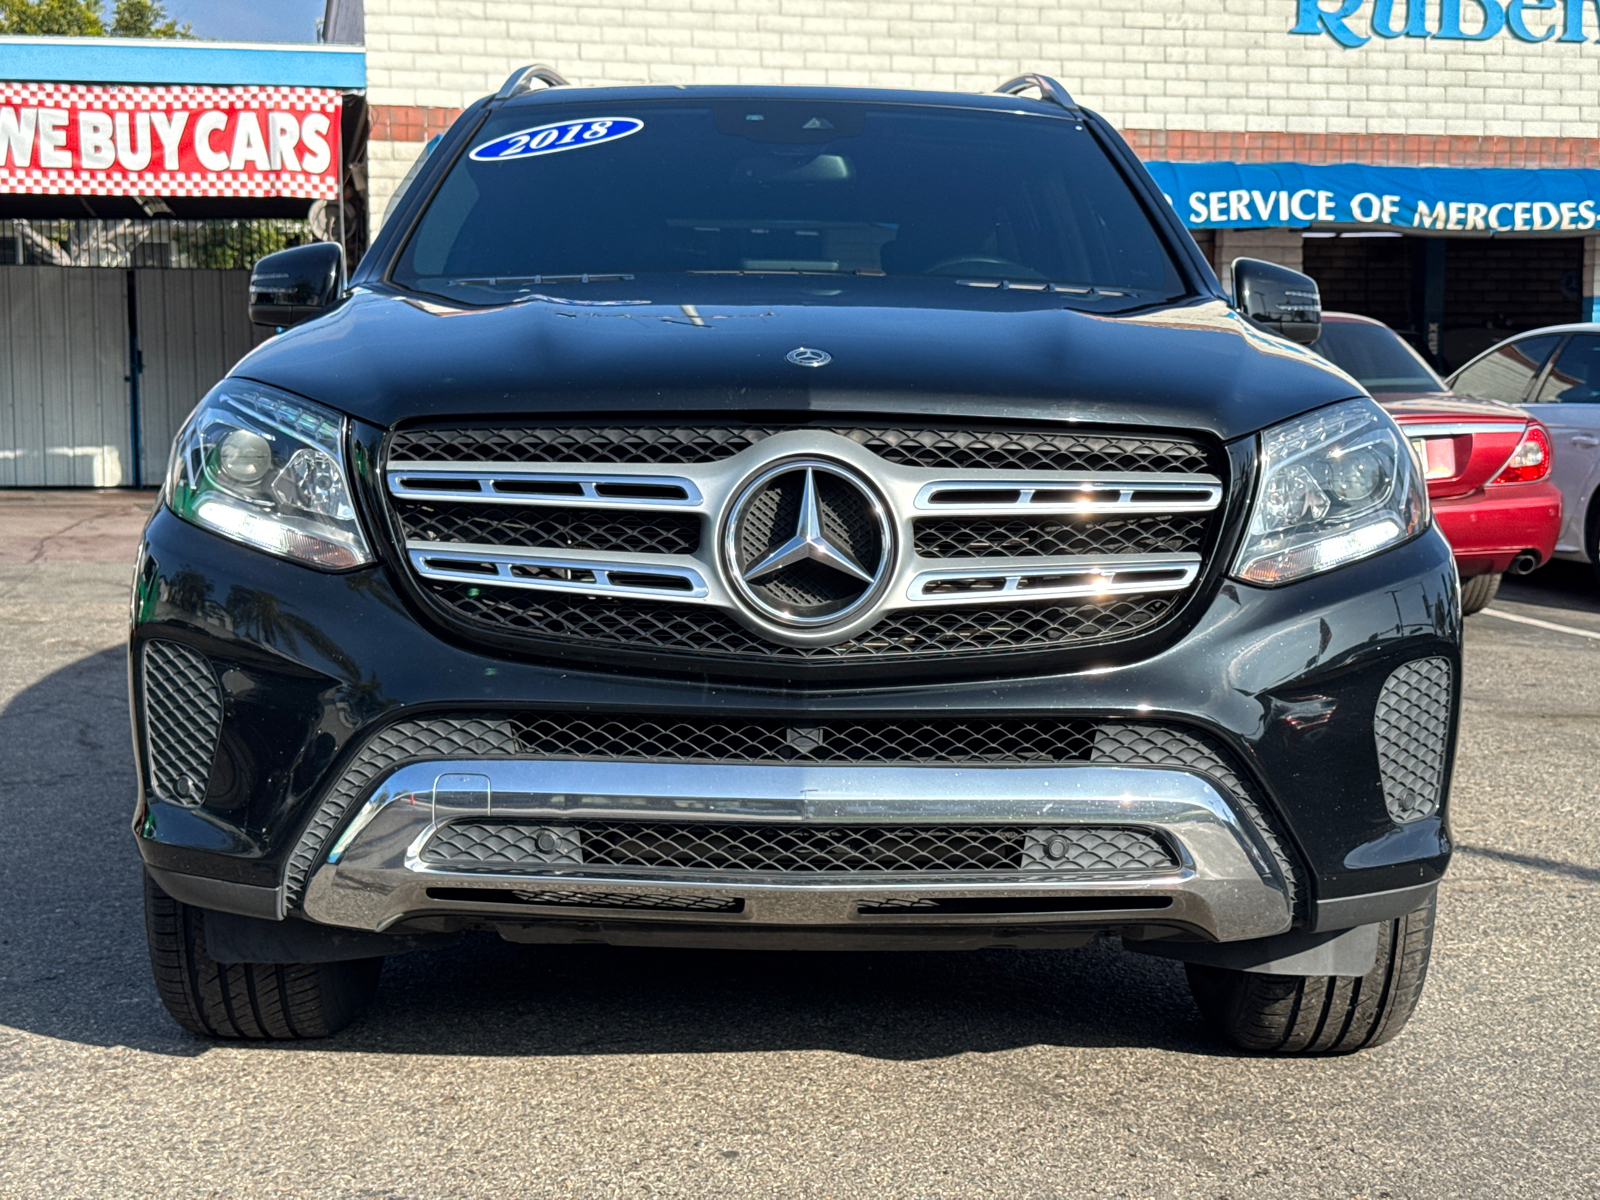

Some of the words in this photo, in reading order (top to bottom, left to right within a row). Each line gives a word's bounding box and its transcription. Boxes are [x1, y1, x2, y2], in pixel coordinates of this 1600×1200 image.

[0, 106, 73, 169] WE
[79, 111, 190, 171] BUY
[194, 110, 331, 174] CARS
[499, 121, 613, 156] 2018
[1189, 189, 1336, 223] SERVICE
[1350, 192, 1401, 223] OF
